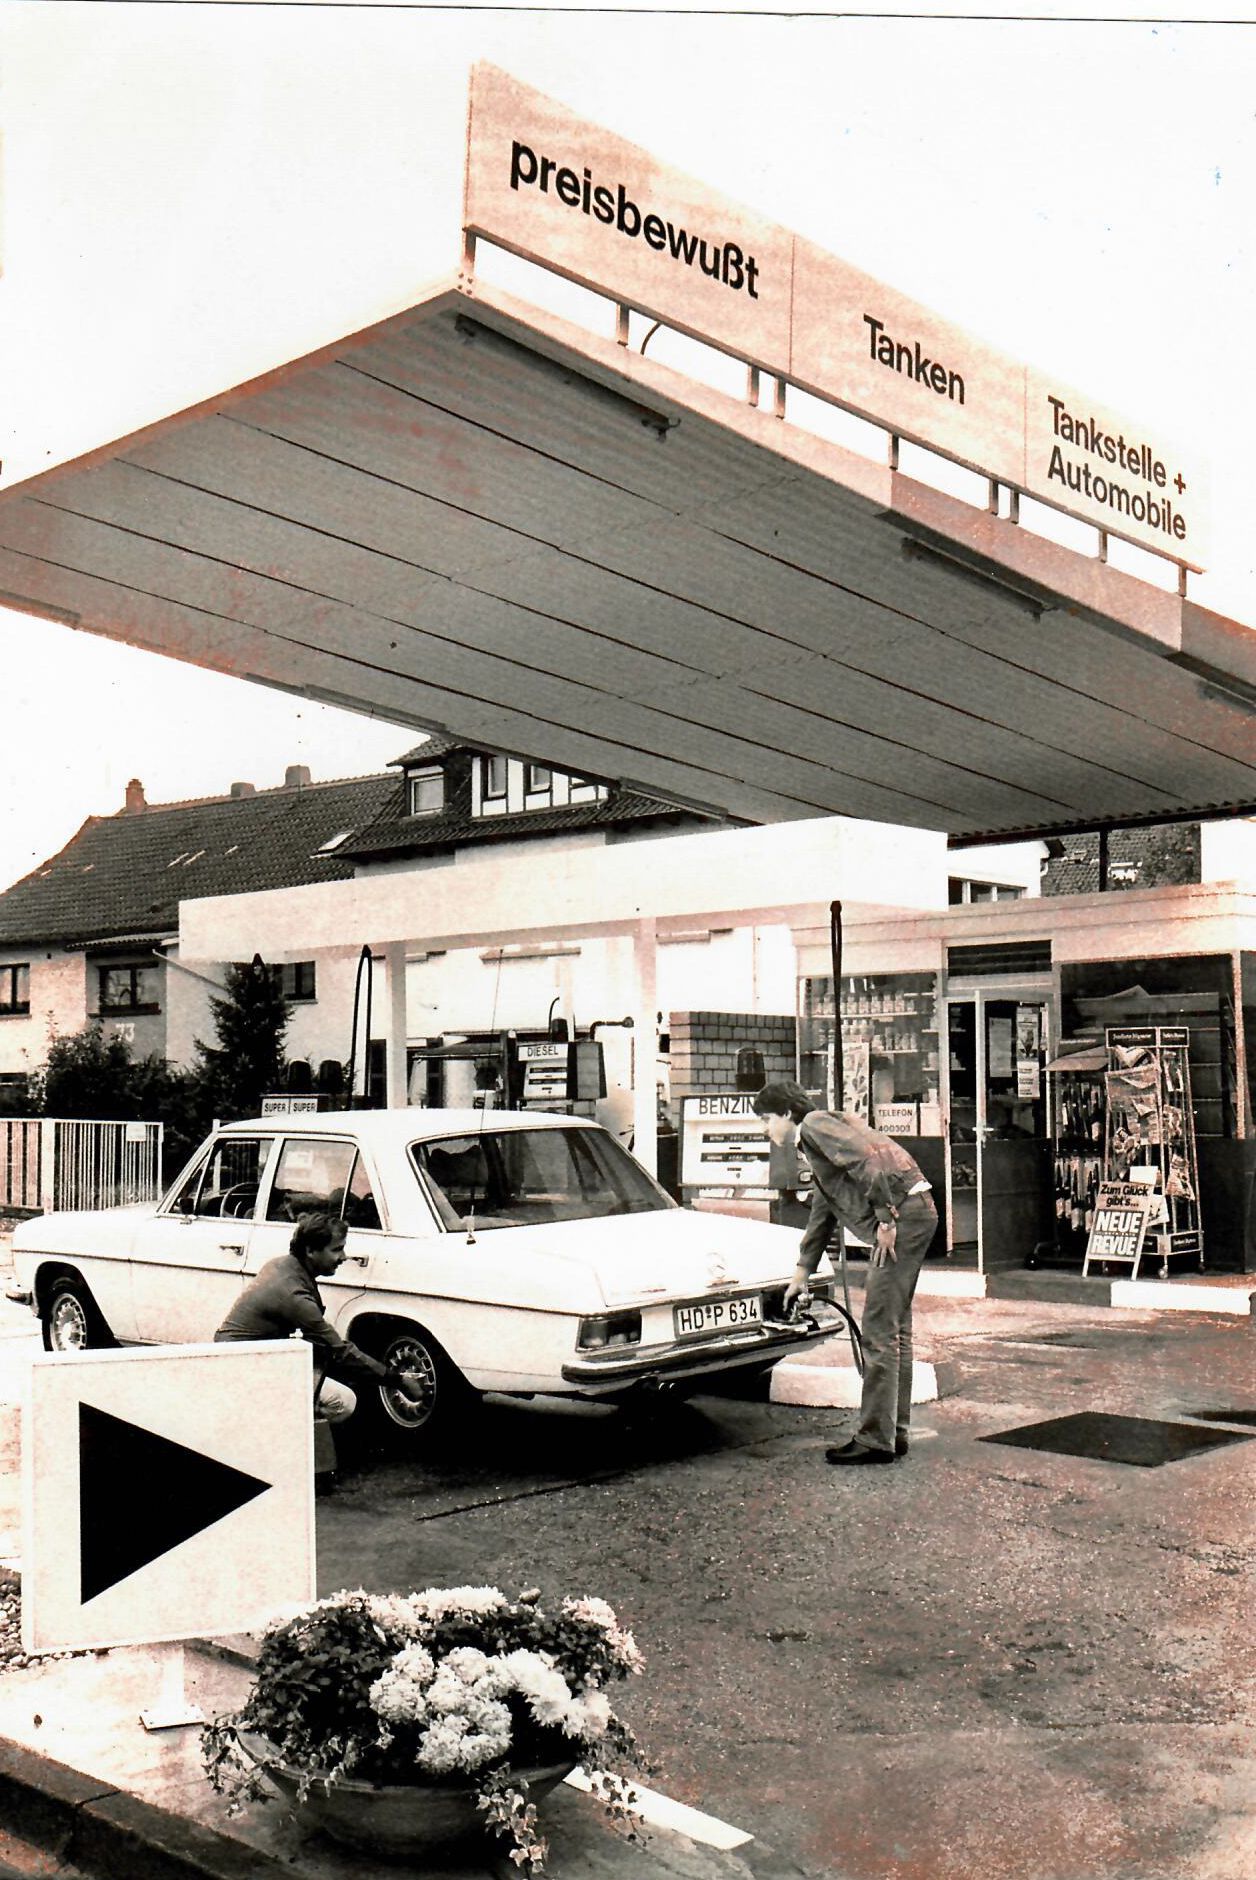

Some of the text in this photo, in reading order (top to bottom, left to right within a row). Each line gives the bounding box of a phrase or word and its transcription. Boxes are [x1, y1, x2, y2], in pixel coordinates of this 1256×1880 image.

[510, 140, 760, 300] preisbewußt
[863, 313, 965, 405] Tanken
[1047, 395, 1186, 495] Tankstelle +
[1047, 445, 1186, 540] Automobile
[527, 1045, 559, 1057] DIESEL
[264, 1102, 286, 1112] SUPER
[293, 1102, 316, 1112] SUPER
[878, 1108, 913, 1117] TELEFON
[1100, 1184, 1121, 1195] Zum
[1095, 1210, 1142, 1233] NEUE
[1090, 1234, 1138, 1256] REVUE
[729, 1300, 757, 1322] 634
